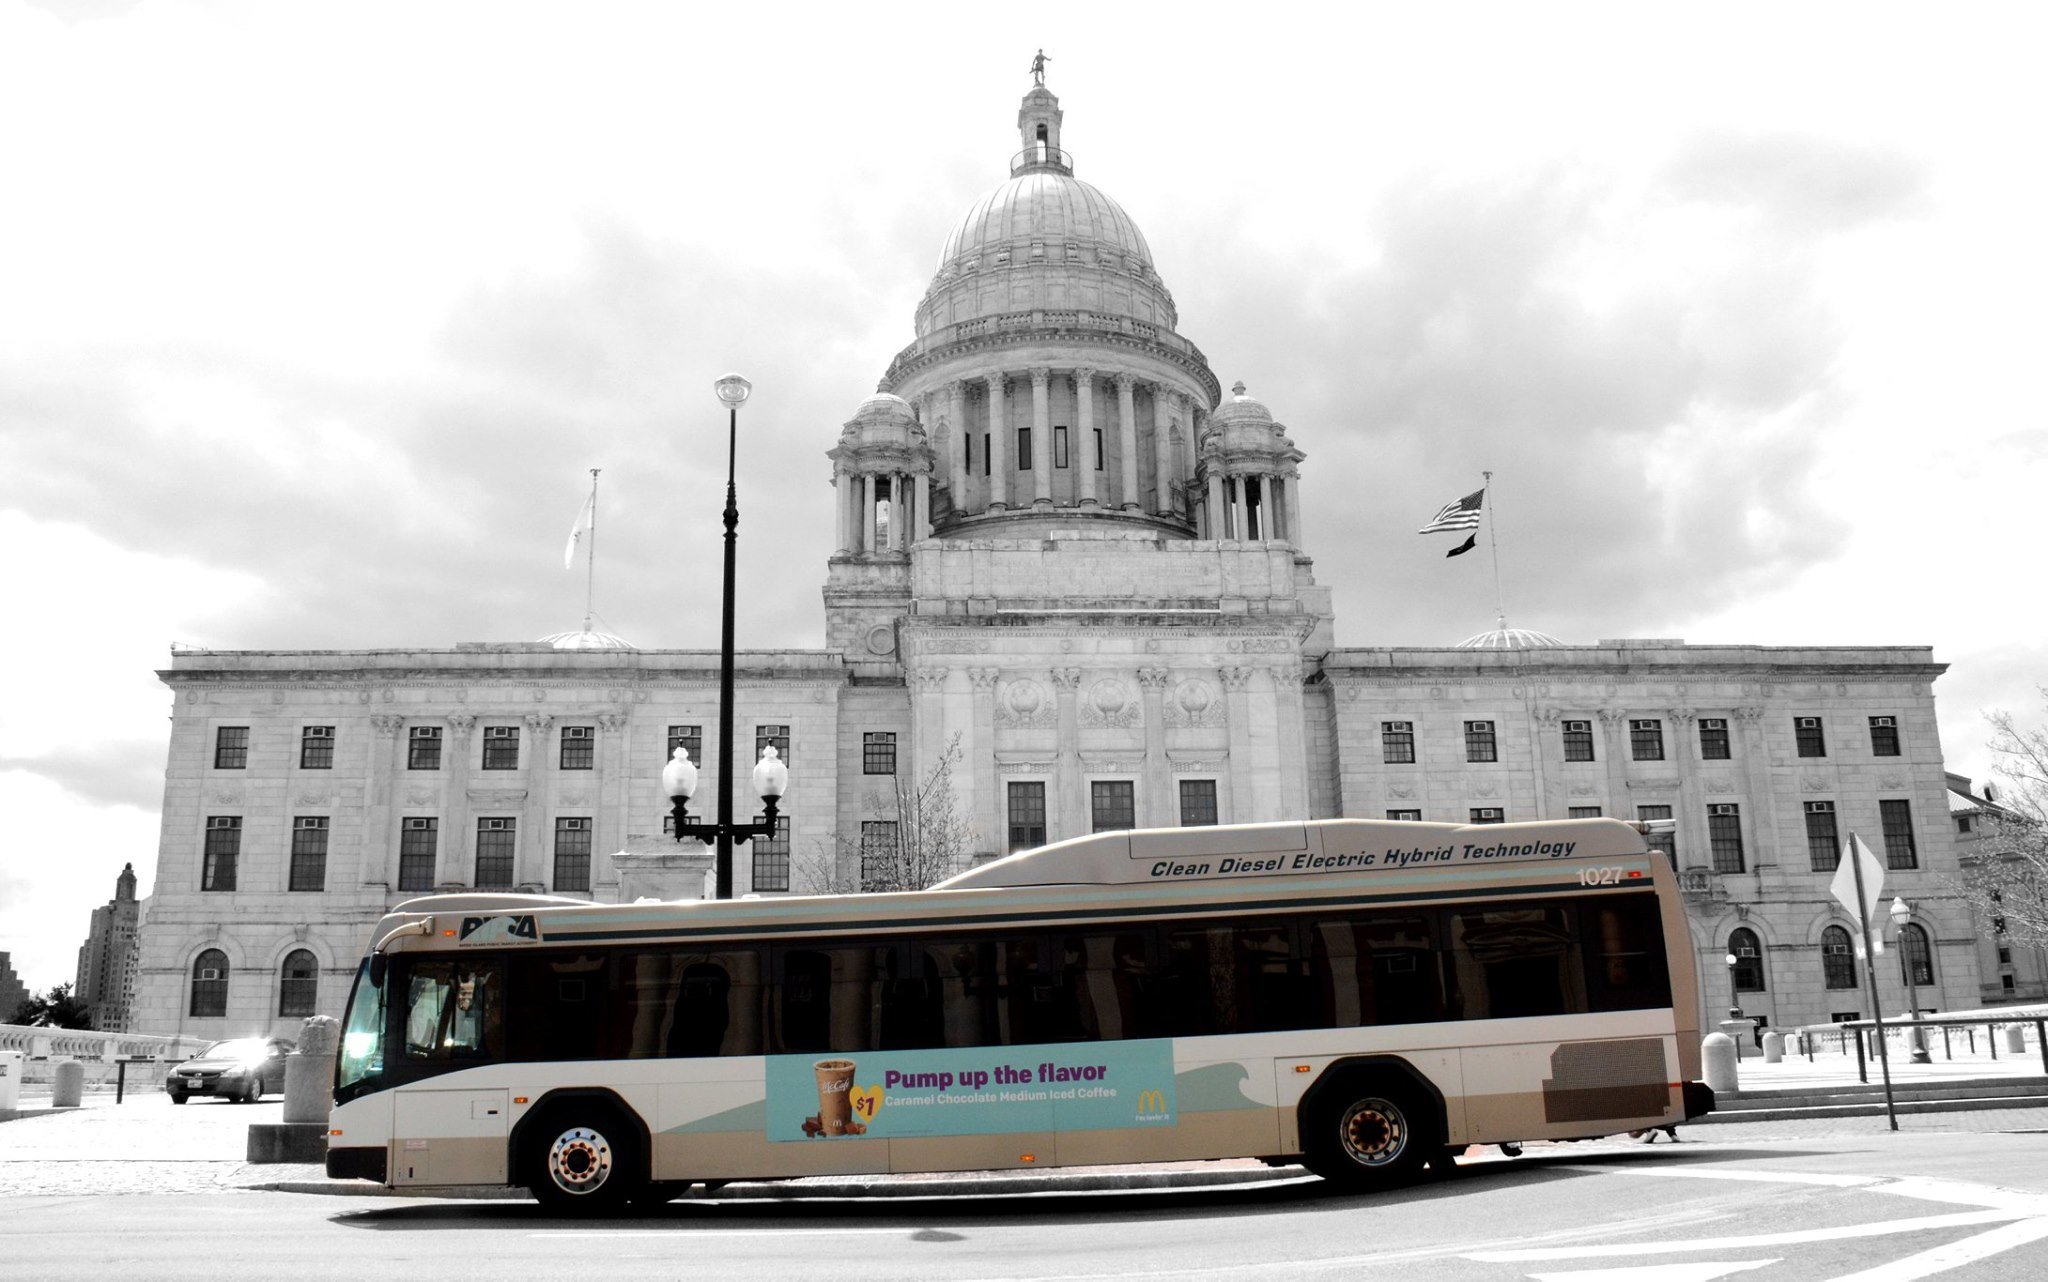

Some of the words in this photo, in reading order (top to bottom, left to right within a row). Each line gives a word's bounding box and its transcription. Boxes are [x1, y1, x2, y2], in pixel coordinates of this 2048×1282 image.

[1150, 861, 1210, 877] Clean
[1218, 855, 1285, 874] Diesel
[1292, 850, 1376, 869] Electric
[1383, 845, 1453, 867] Hybrid
[1462, 840, 1577, 860] Technology
[1576, 866, 1624, 886] 1027
[885, 1069, 954, 1092] Pump
[958, 1070, 989, 1090] up
[993, 1065, 1033, 1085] the
[1038, 1062, 1107, 1083] flavor
[856, 1096, 875, 1117] $1
[884, 1094, 934, 1107] Caramel
[937, 1092, 998, 1105] Chocolate
[1000, 1089, 1047, 1102] Medium
[1050, 1087, 1076, 1100] Iced
[1077, 1086, 1118, 1099] Coffee
